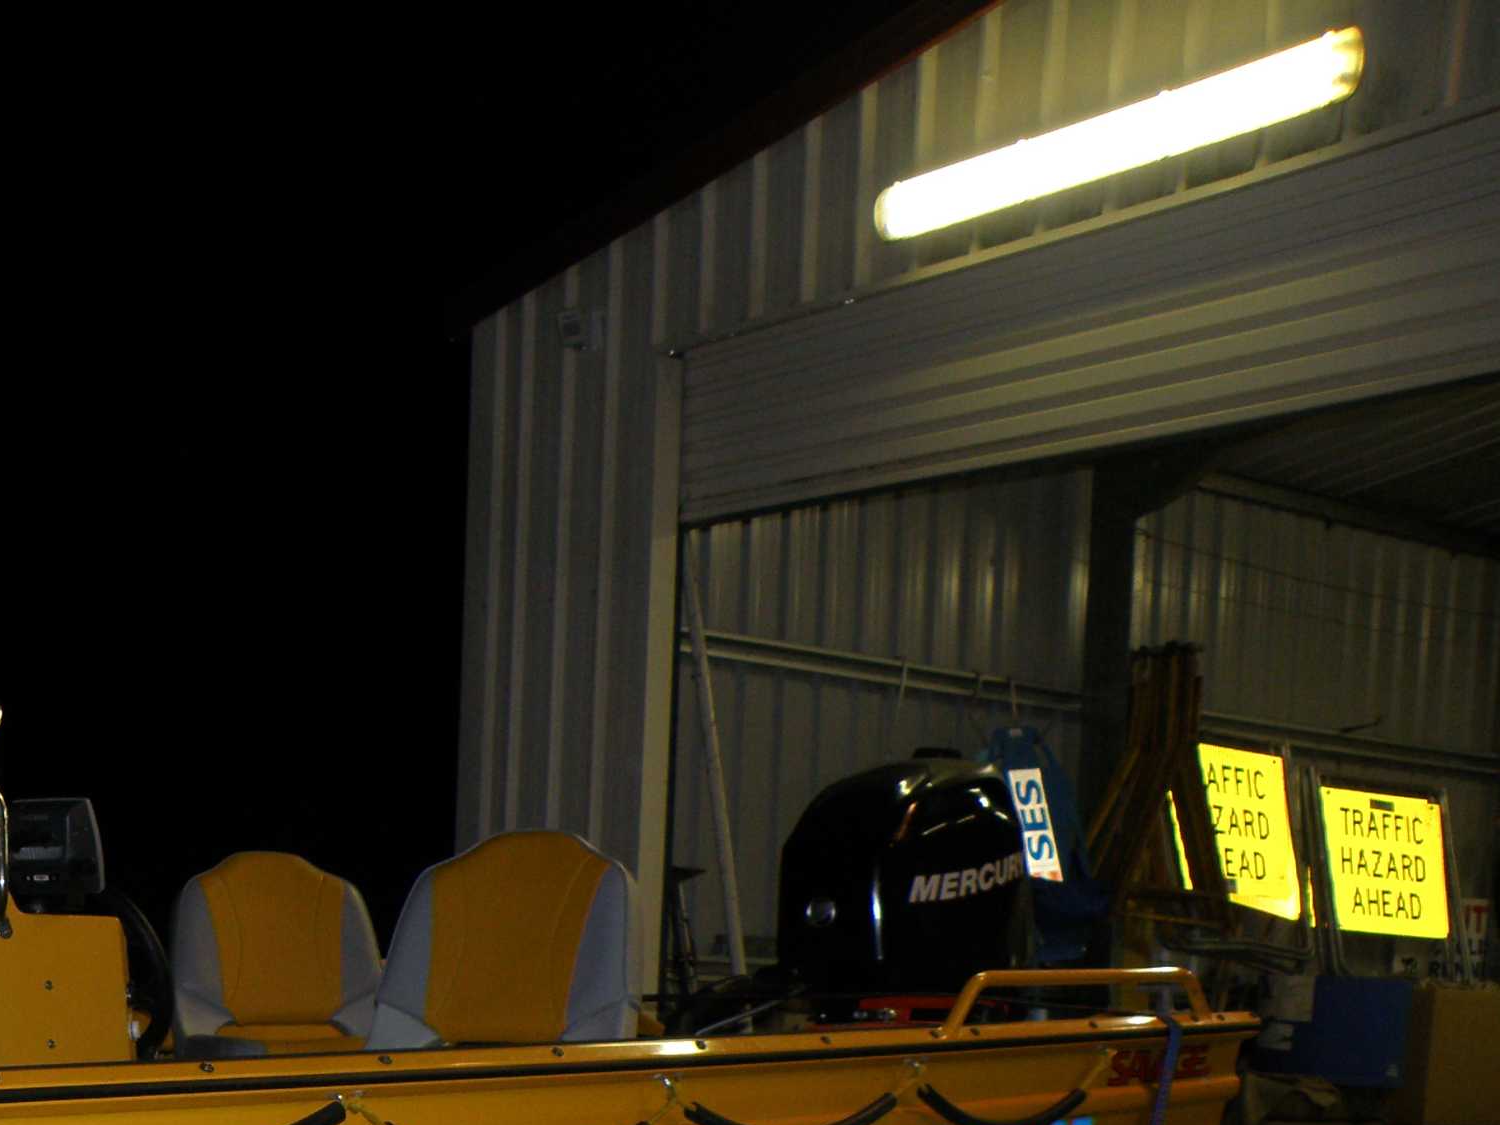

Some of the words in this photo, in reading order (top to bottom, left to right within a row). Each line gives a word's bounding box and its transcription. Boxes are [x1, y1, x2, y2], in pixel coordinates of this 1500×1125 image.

[1207, 761, 1267, 800] AFFIC
[1014, 778, 1055, 861] SES
[1211, 804, 1270, 841] ZARD
[1339, 806, 1425, 845] TRAFFIC
[908, 852, 1024, 904] MERCUR
[1223, 847, 1267, 881] EAD
[1340, 845, 1427, 884] HAZARD
[1351, 886, 1423, 921] AHEAD
